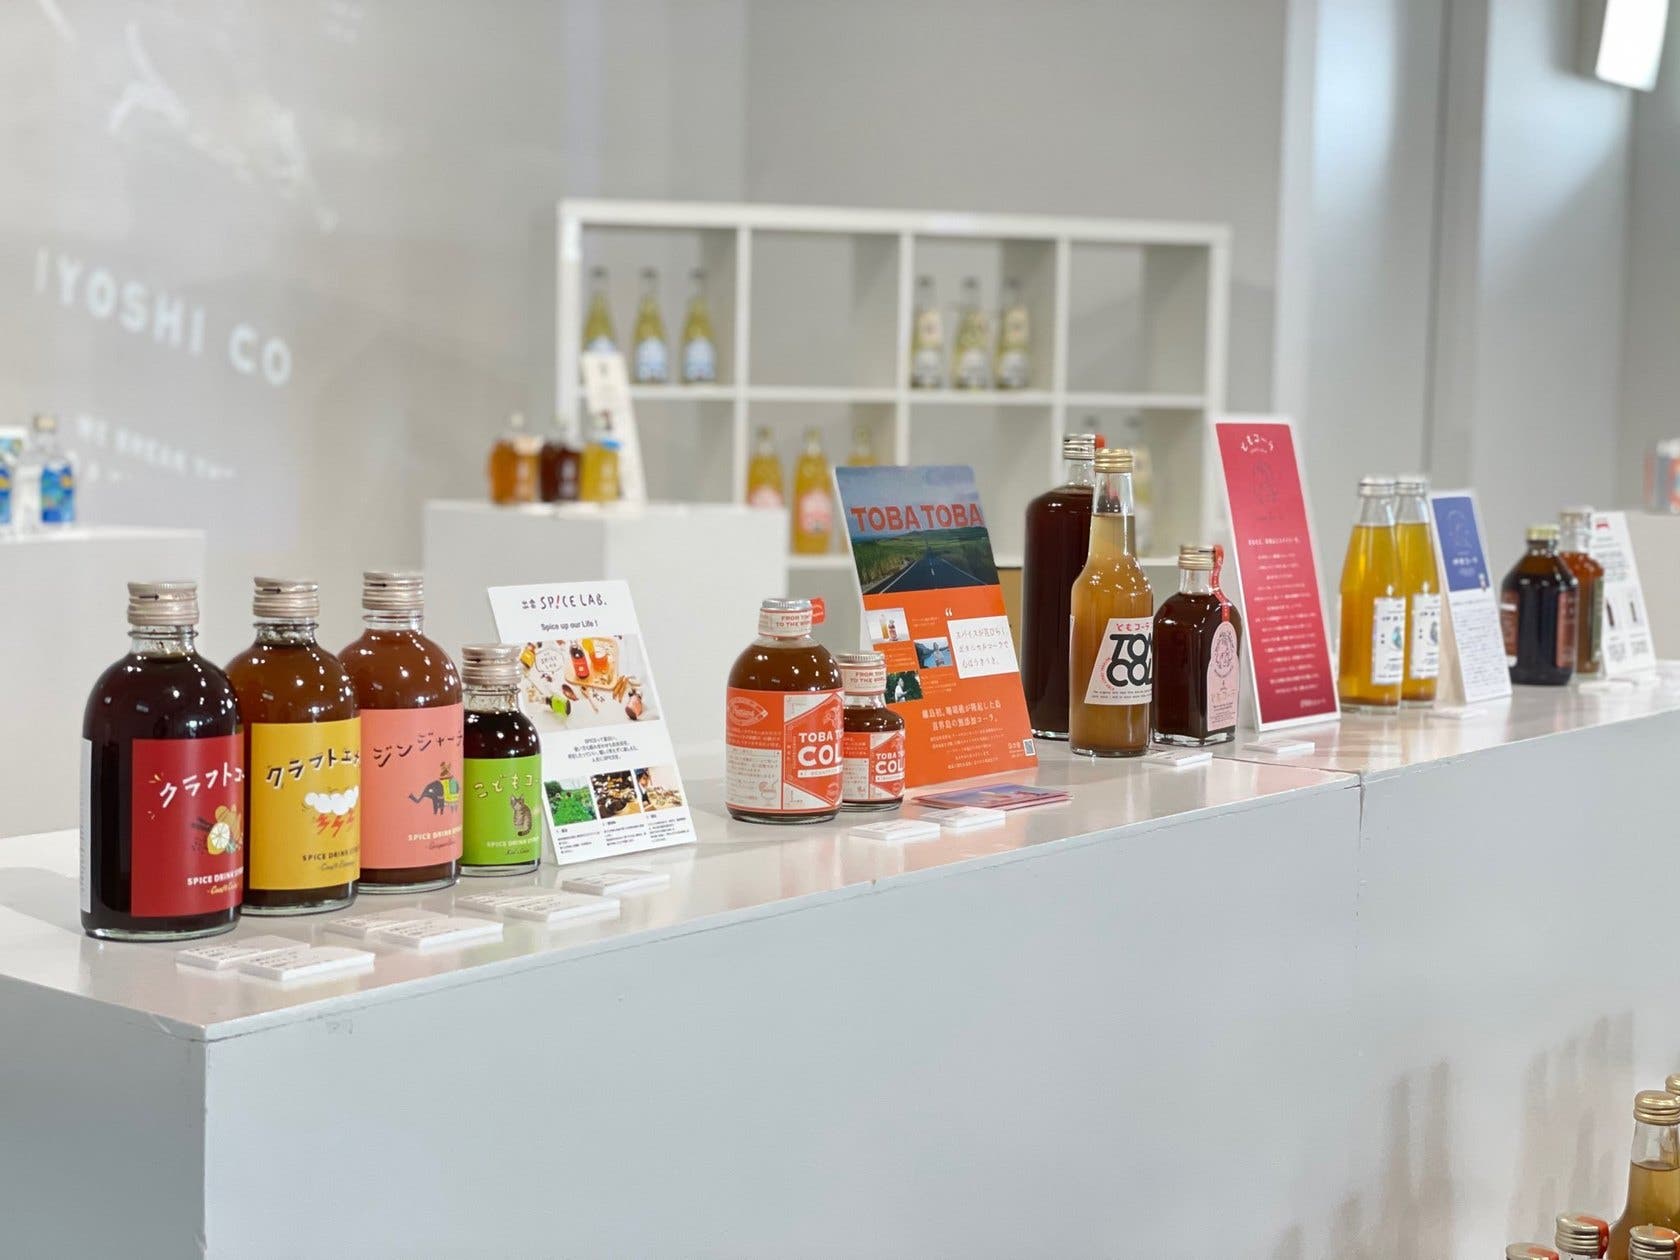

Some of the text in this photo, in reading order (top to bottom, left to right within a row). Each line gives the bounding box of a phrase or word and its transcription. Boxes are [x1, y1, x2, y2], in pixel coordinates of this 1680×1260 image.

[850, 503, 984, 533] TOBA TOBA
[541, 622, 559, 631] Spice
[560, 623, 569, 631] up
[798, 731, 833, 743] TOBA
[876, 752, 897, 760] TOBA
[408, 833, 431, 841] SPICE
[302, 853, 326, 862] SPICE
[328, 850, 348, 860] DRINK
[187, 876, 213, 886] SPICE
